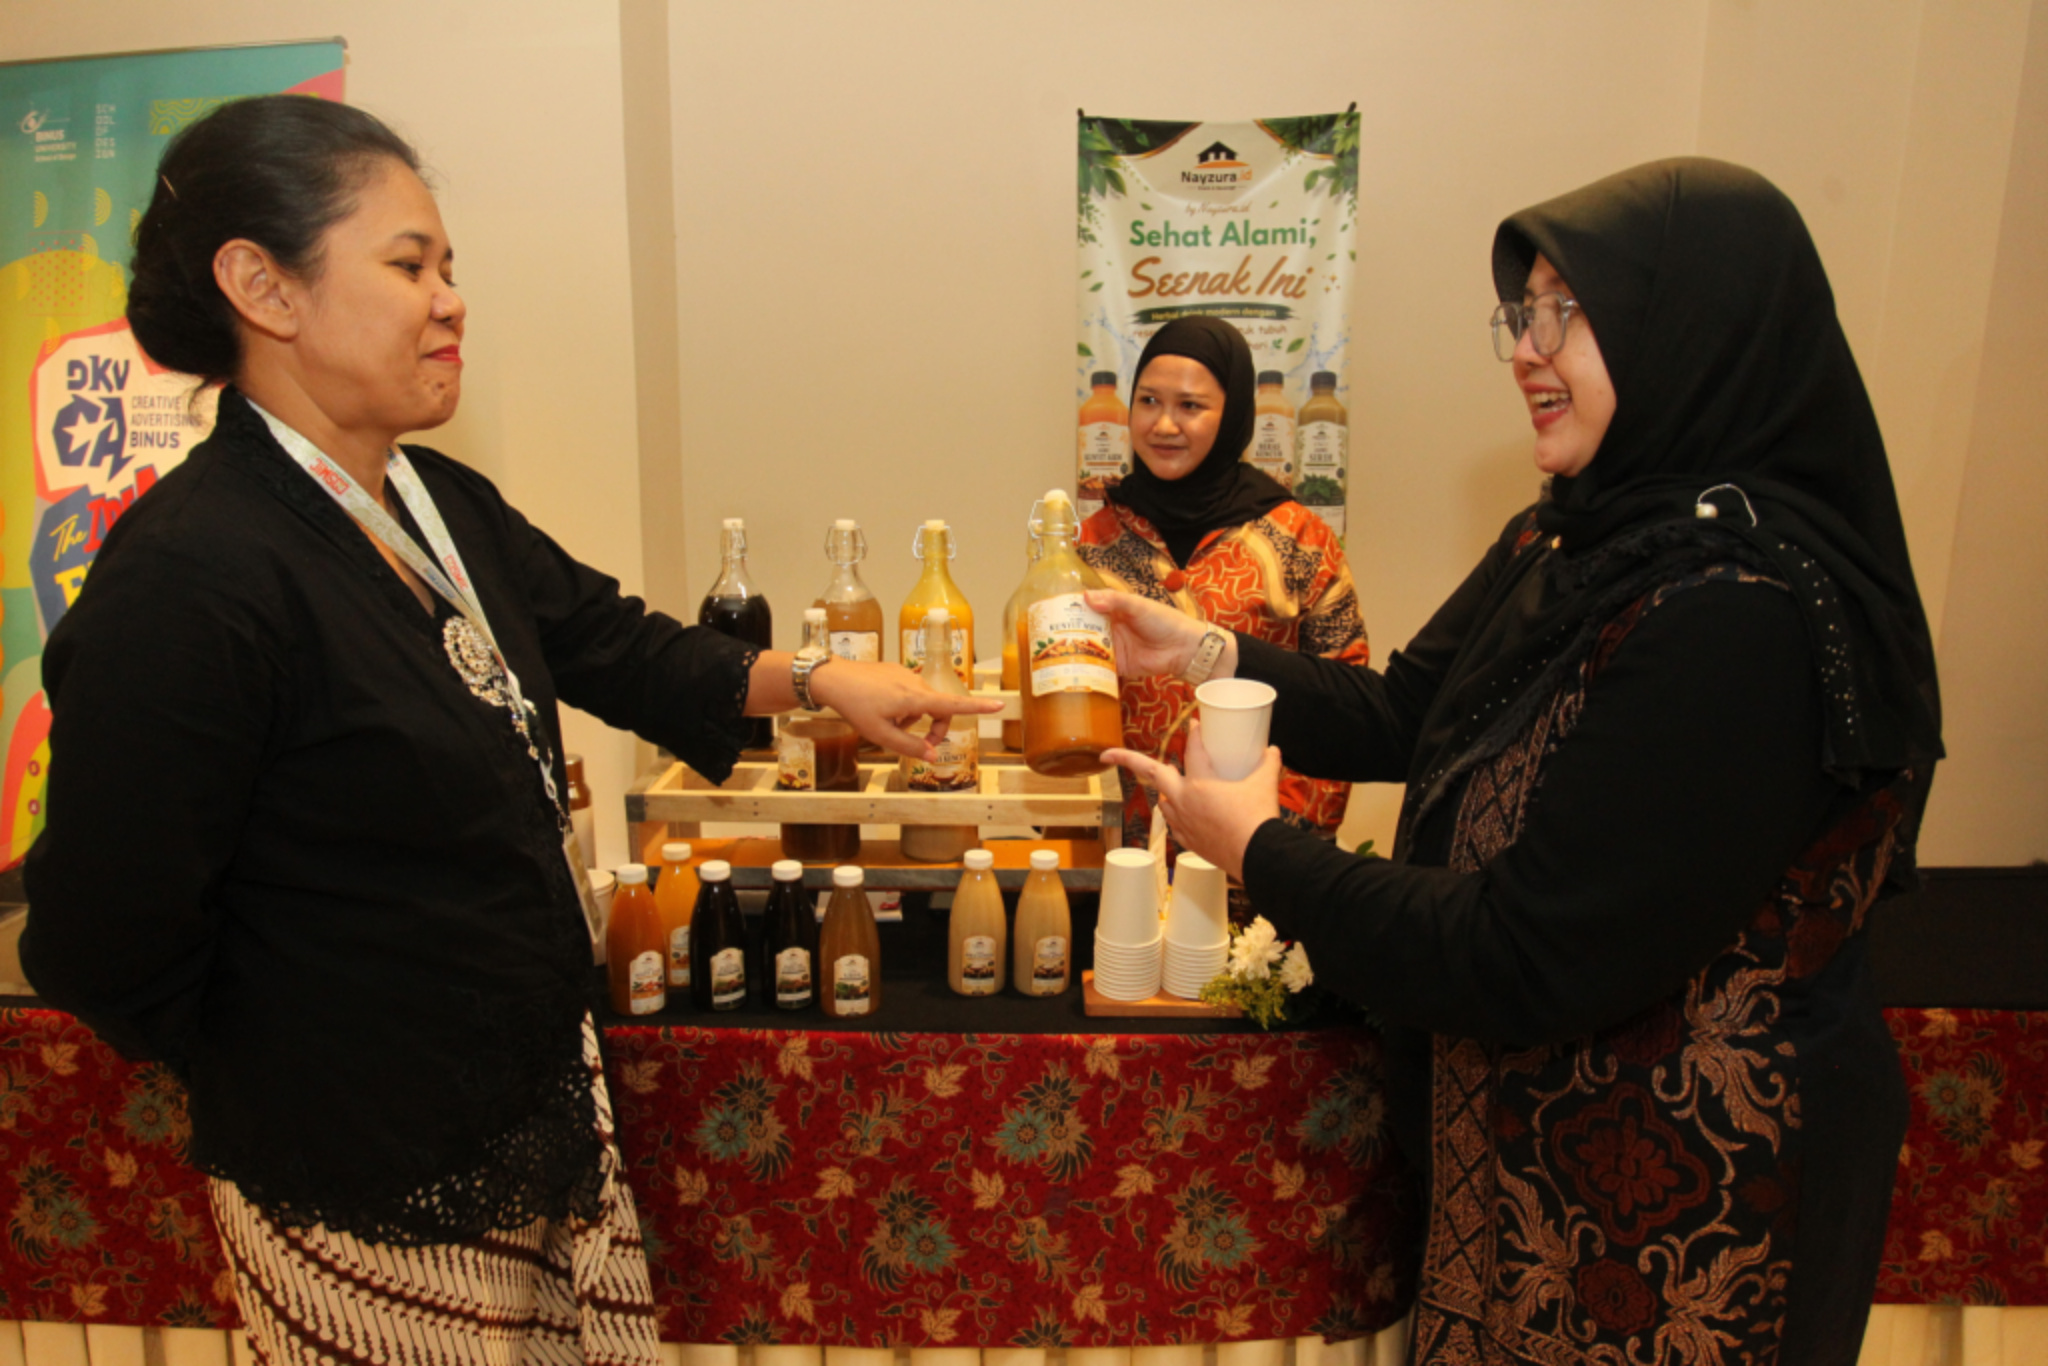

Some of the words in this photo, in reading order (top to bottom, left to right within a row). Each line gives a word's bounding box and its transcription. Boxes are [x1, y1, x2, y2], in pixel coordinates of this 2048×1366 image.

[1129, 219, 1212, 247] Sehat
[1219, 218, 1316, 248] Alami,
[1127, 254, 1252, 299] Seenak
[1255, 255, 1314, 299] Ini
[67, 355, 130, 392] DKV
[132, 395, 181, 409] CREATIVE
[131, 413, 203, 427] ADVERTISING
[130, 431, 180, 449] BINUS
[50, 514, 88, 562] The
